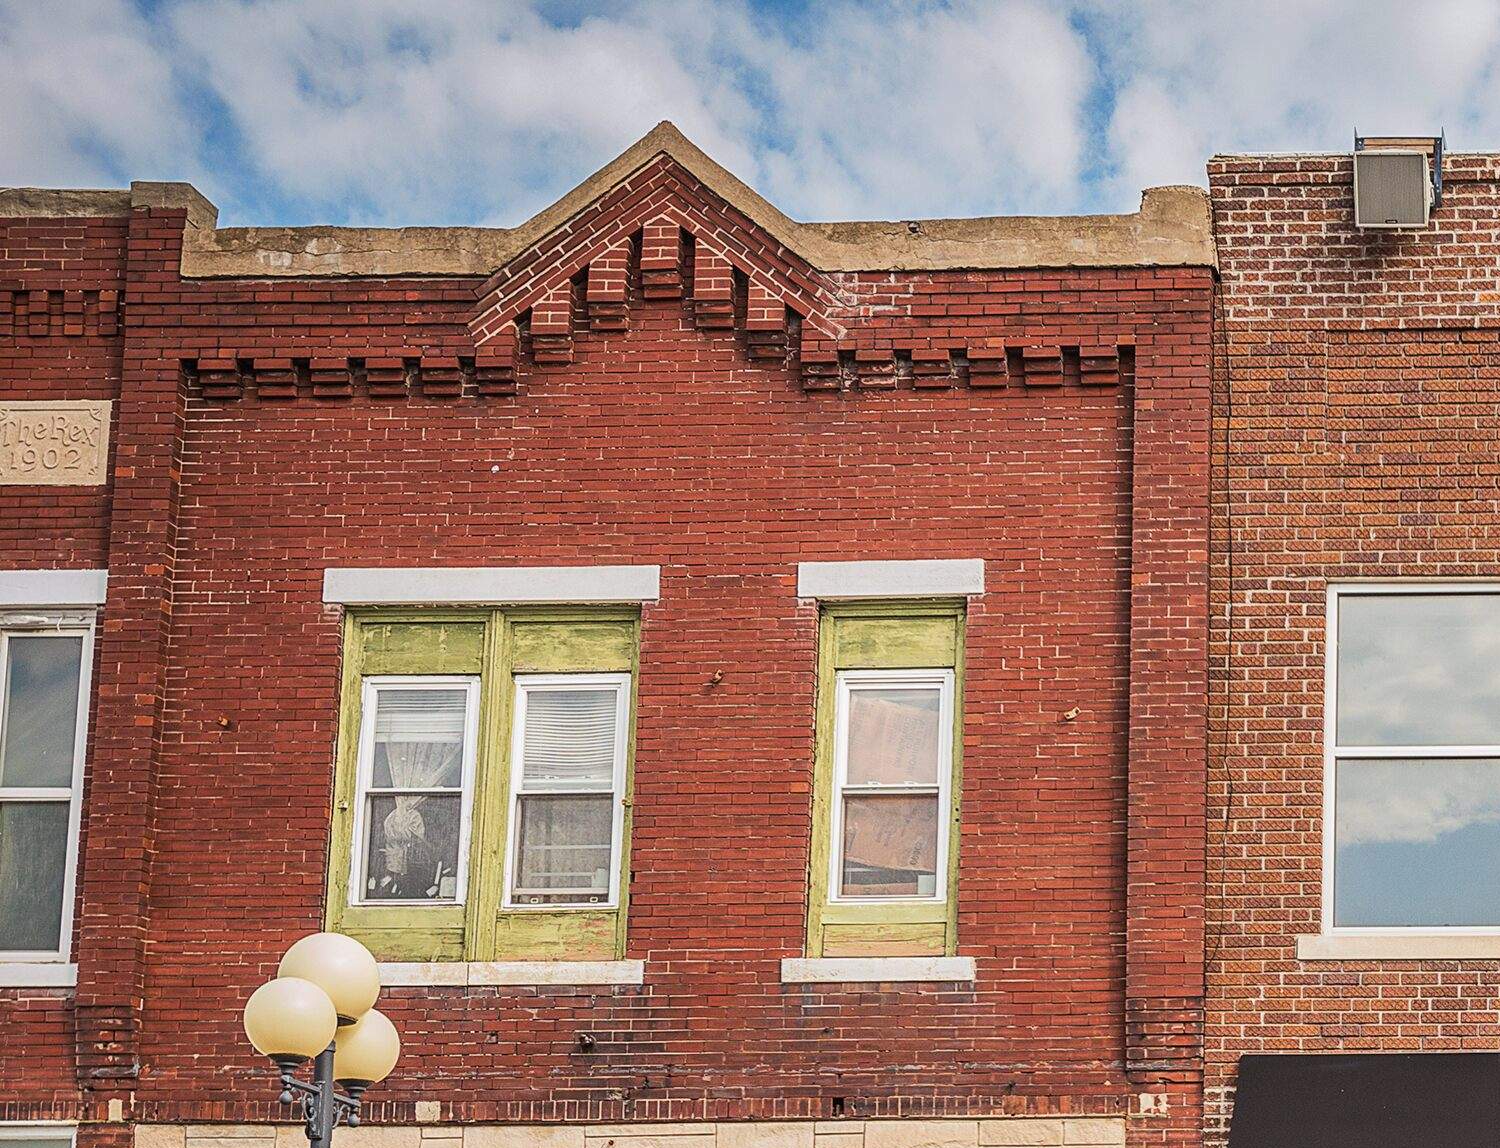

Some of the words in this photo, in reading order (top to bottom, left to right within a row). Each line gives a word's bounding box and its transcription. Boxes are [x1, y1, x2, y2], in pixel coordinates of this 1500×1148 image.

[2, 419, 47, 447] The
[50, 416, 99, 447] Rex
[10, 450, 81, 472] 1902
